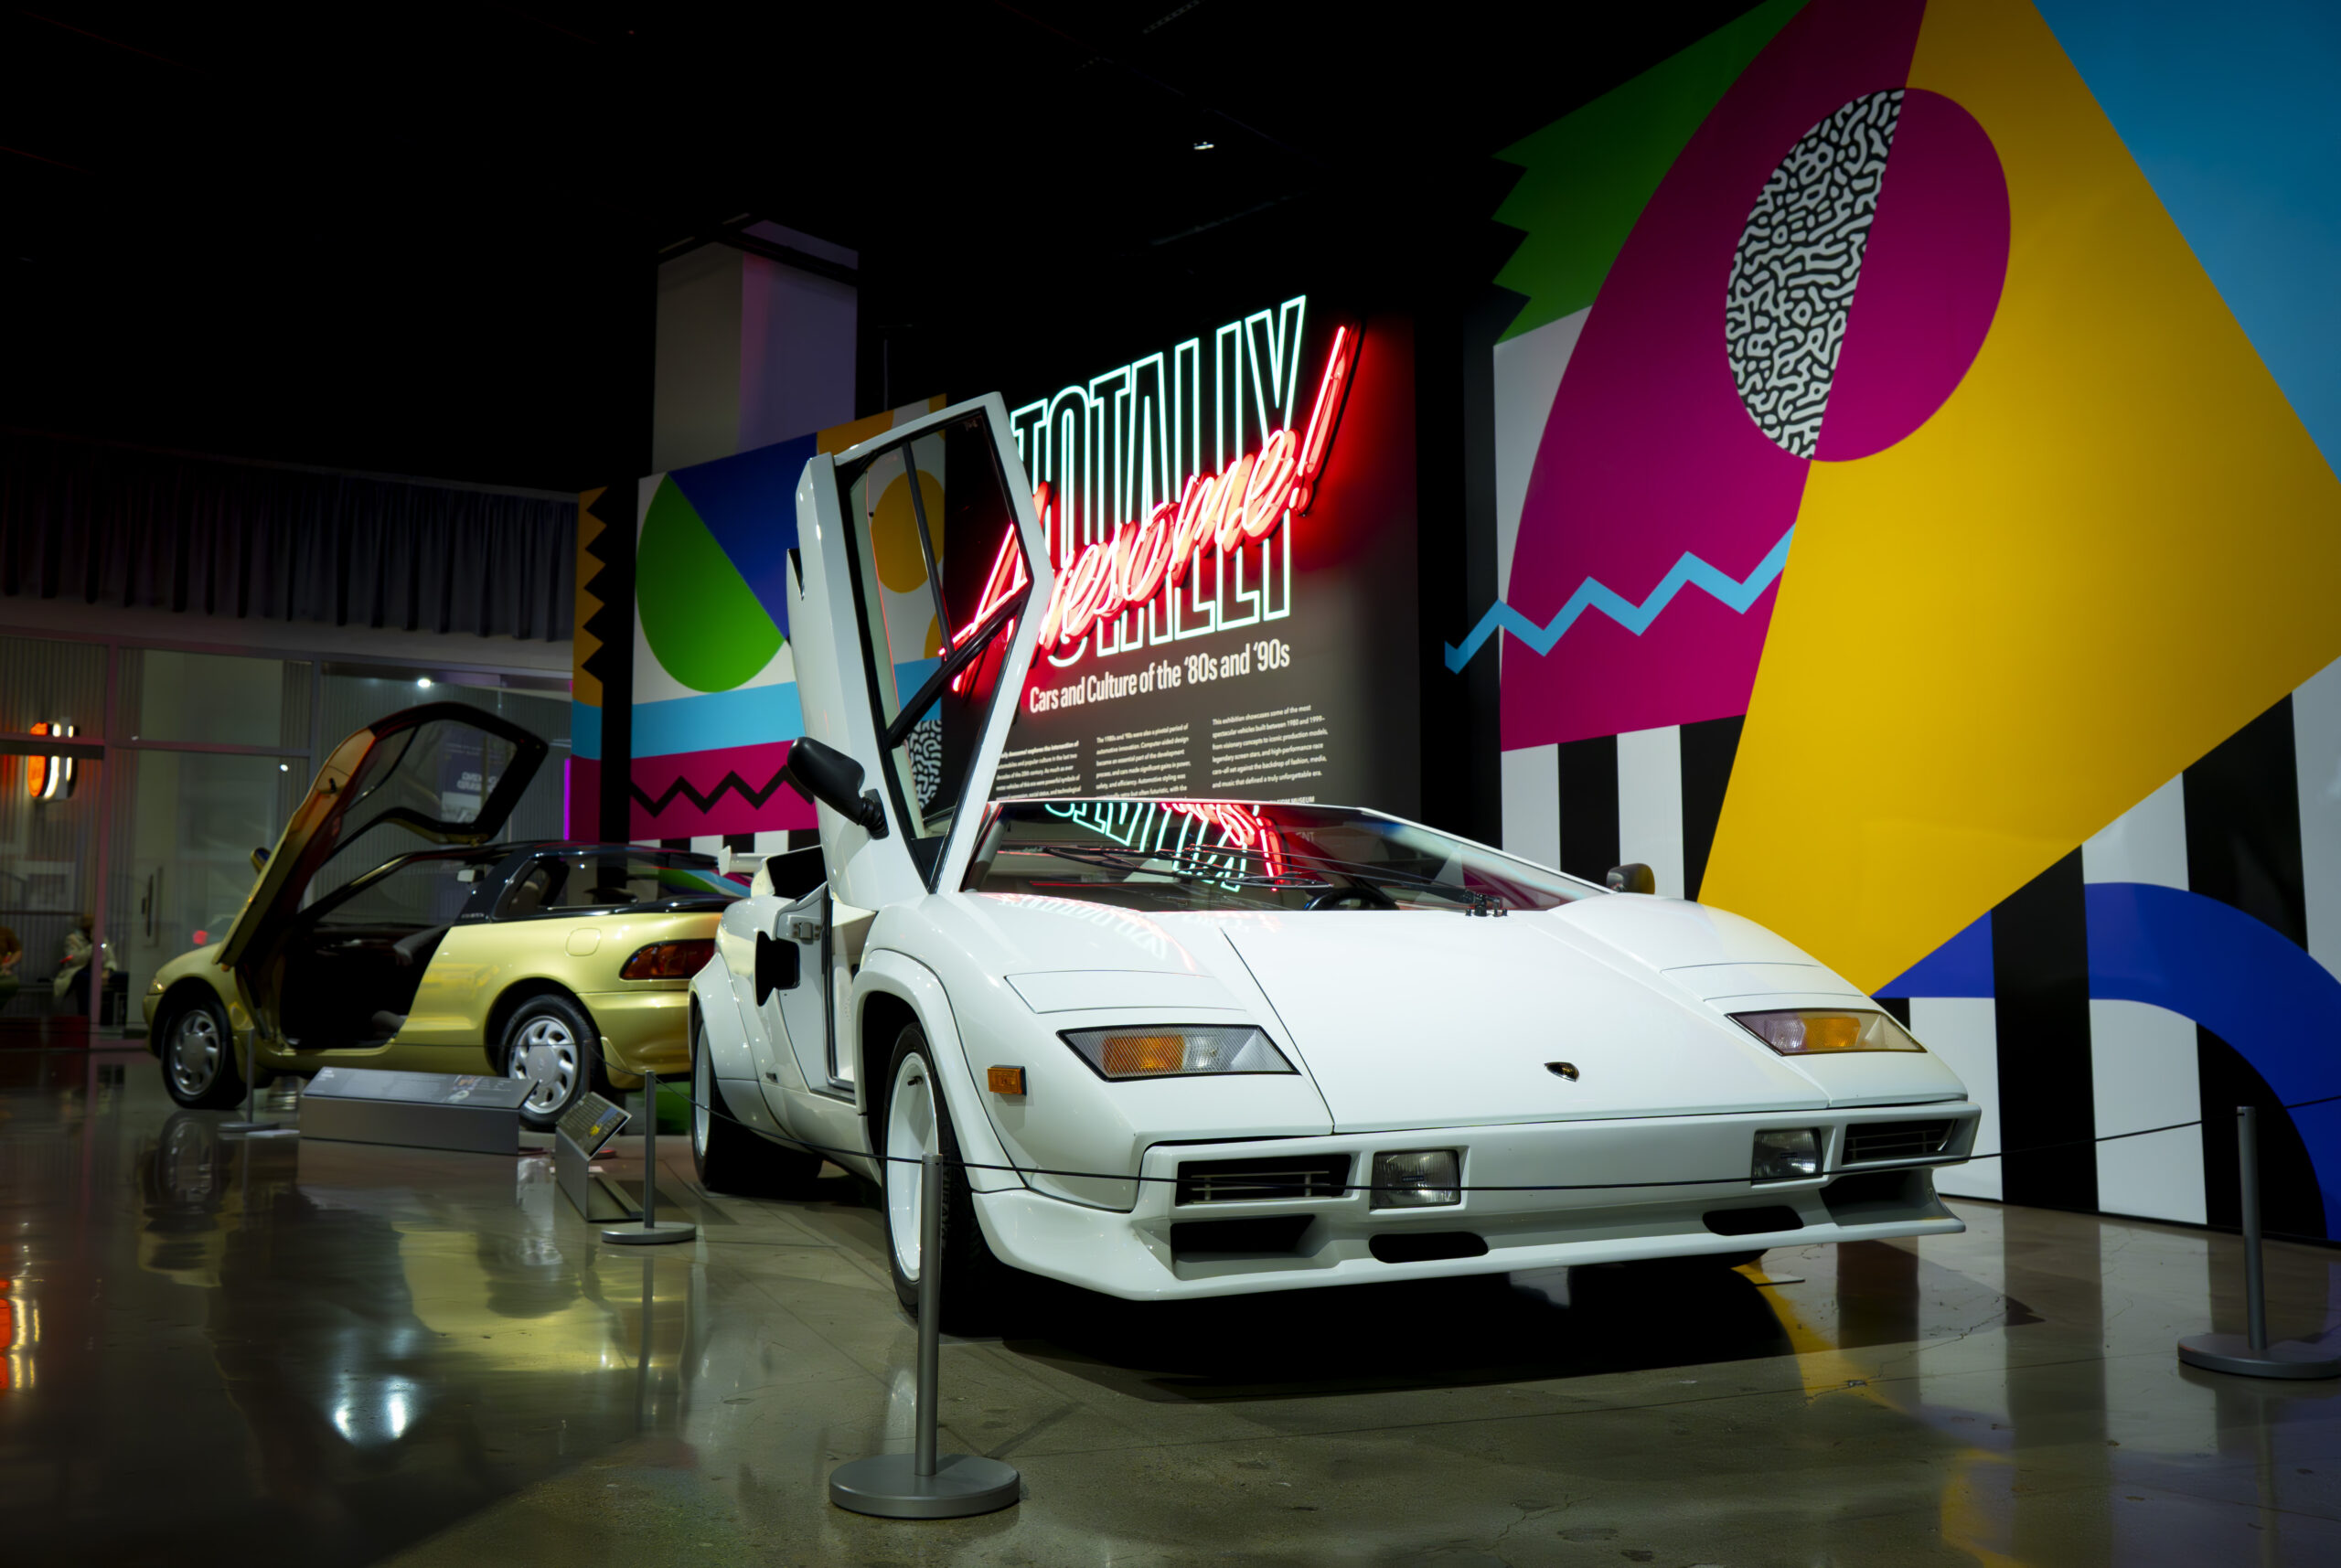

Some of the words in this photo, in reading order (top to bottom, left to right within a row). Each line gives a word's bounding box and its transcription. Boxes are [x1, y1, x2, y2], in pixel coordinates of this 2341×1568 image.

[1010, 293, 1308, 668] TOTALLY
[1030, 687, 1059, 713] Cars
[1060, 676, 1085, 708] and
[1086, 671, 1138, 703] Culture
[1139, 662, 1156, 694] of
[1157, 659, 1181, 689] the
[1183, 652, 1218, 685] ‘80s
[1220, 643, 1250, 679] and
[1253, 638, 1290, 672] ‘90s
